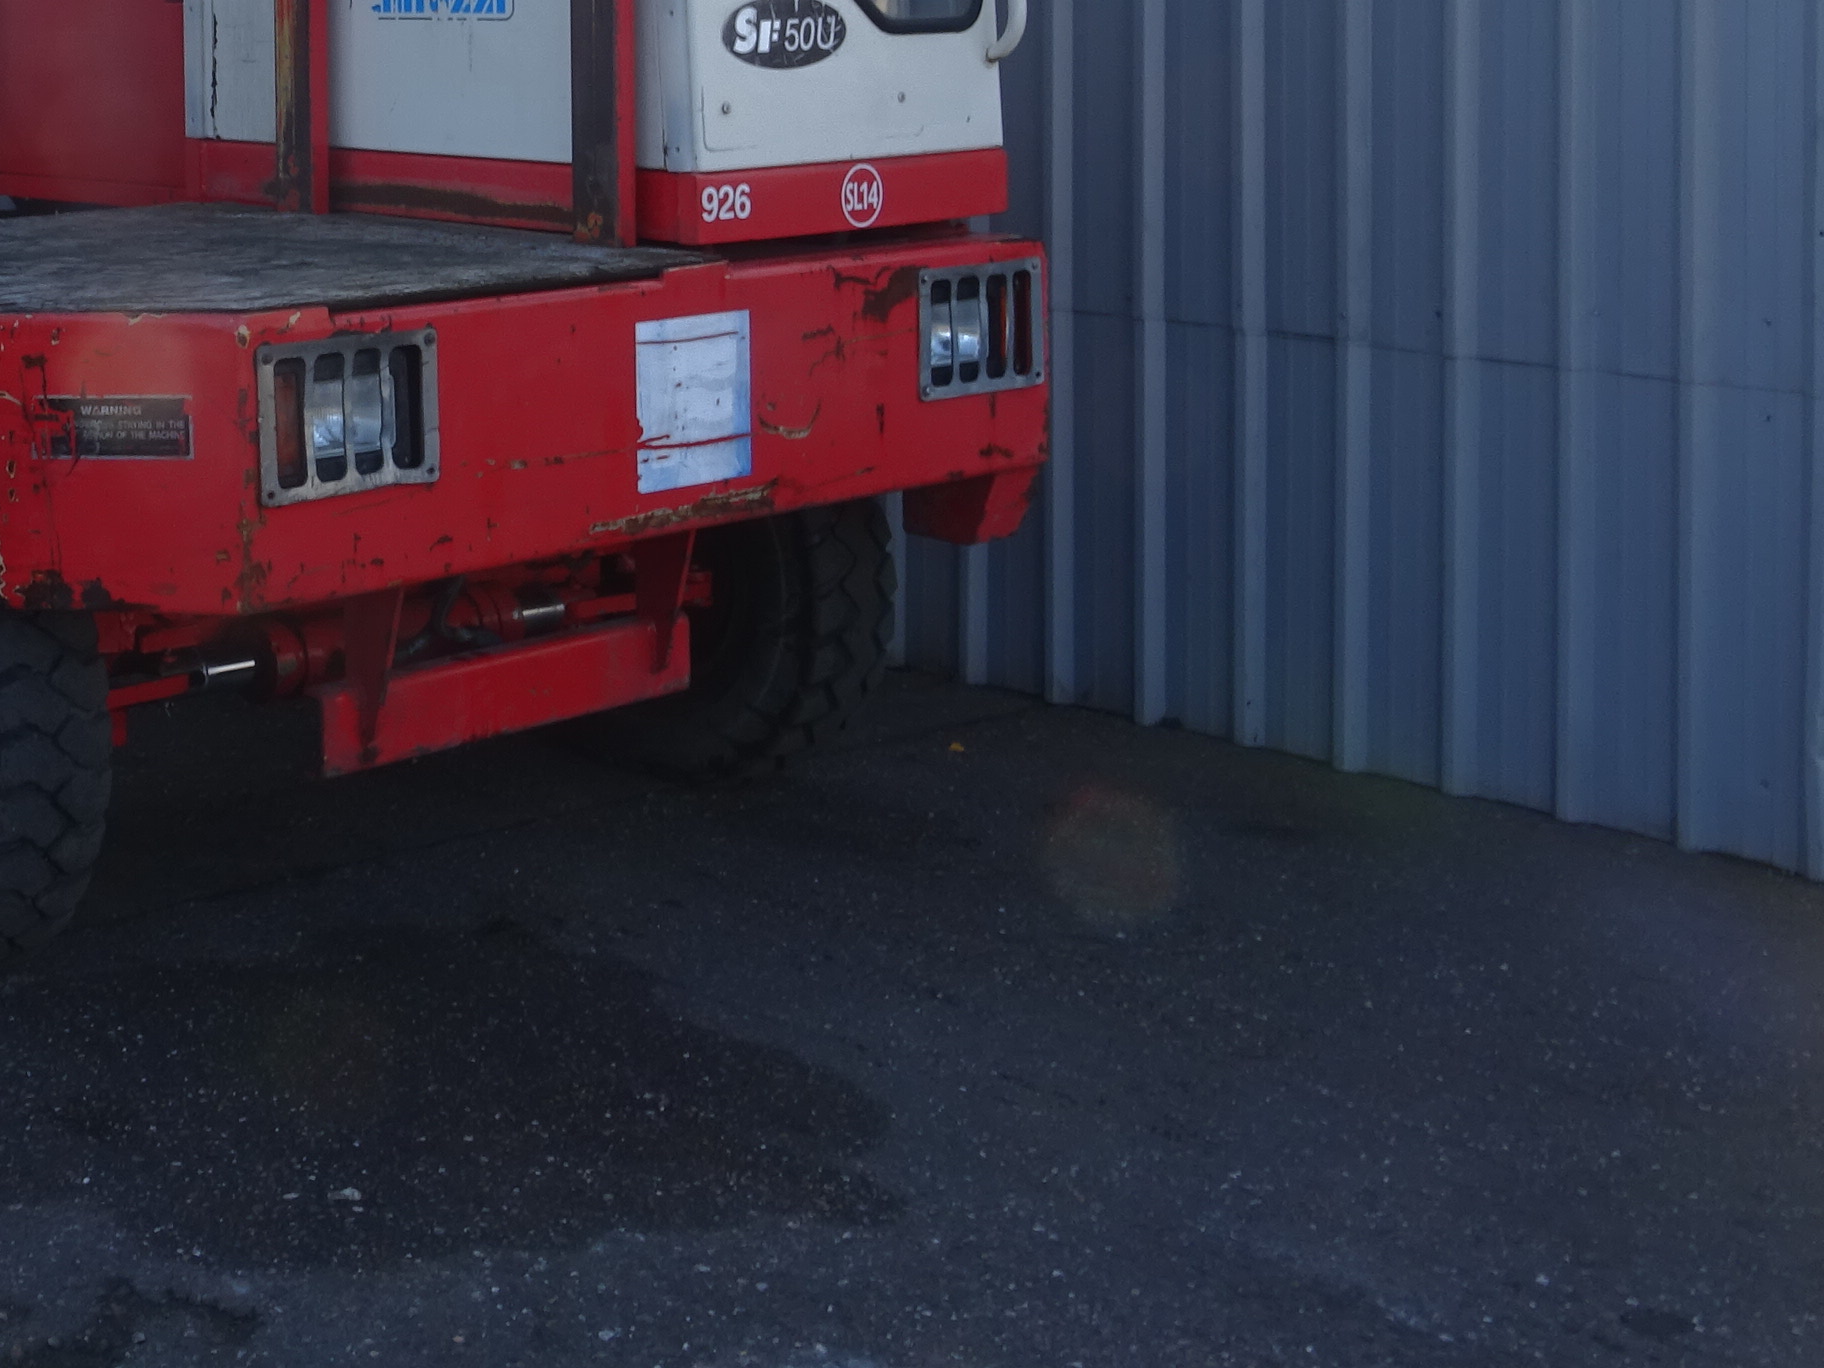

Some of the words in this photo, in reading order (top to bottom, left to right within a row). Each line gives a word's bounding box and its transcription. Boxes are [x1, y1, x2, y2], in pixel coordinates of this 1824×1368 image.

[701, 183, 752, 222] 926
[845, 180, 879, 211] SL14
[80, 405, 142, 416] WARNING
